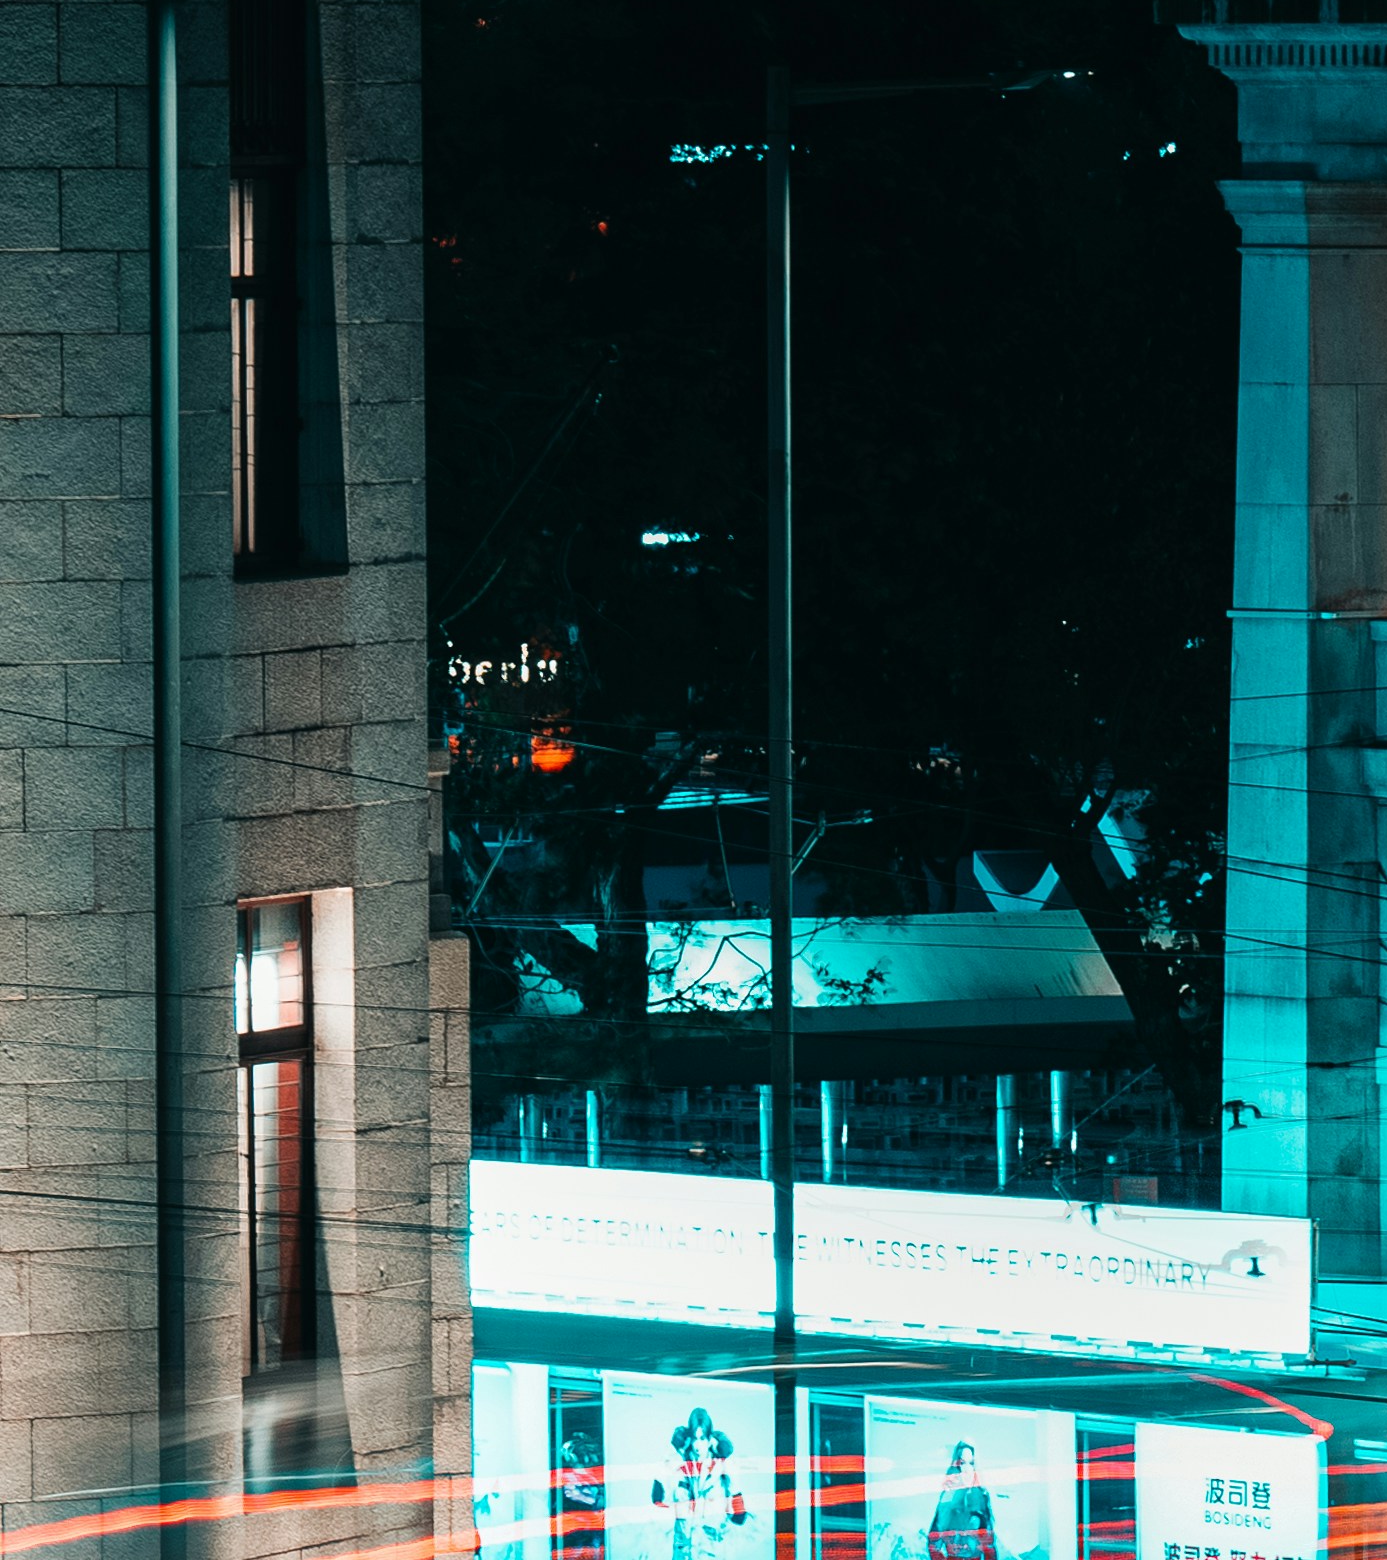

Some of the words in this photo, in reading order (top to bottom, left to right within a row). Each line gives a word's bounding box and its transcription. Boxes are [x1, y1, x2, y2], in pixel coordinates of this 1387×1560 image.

[561, 1216, 744, 1255] DETERMINATION
[817, 1234, 947, 1271] WITNESSES
[955, 1245, 1000, 1276] THE
[1008, 1248, 1212, 1290] EXTRAORDINARY
[1205, 1477, 1271, 1510] 波司登
[1204, 1510, 1272, 1530] BOSIDENG
